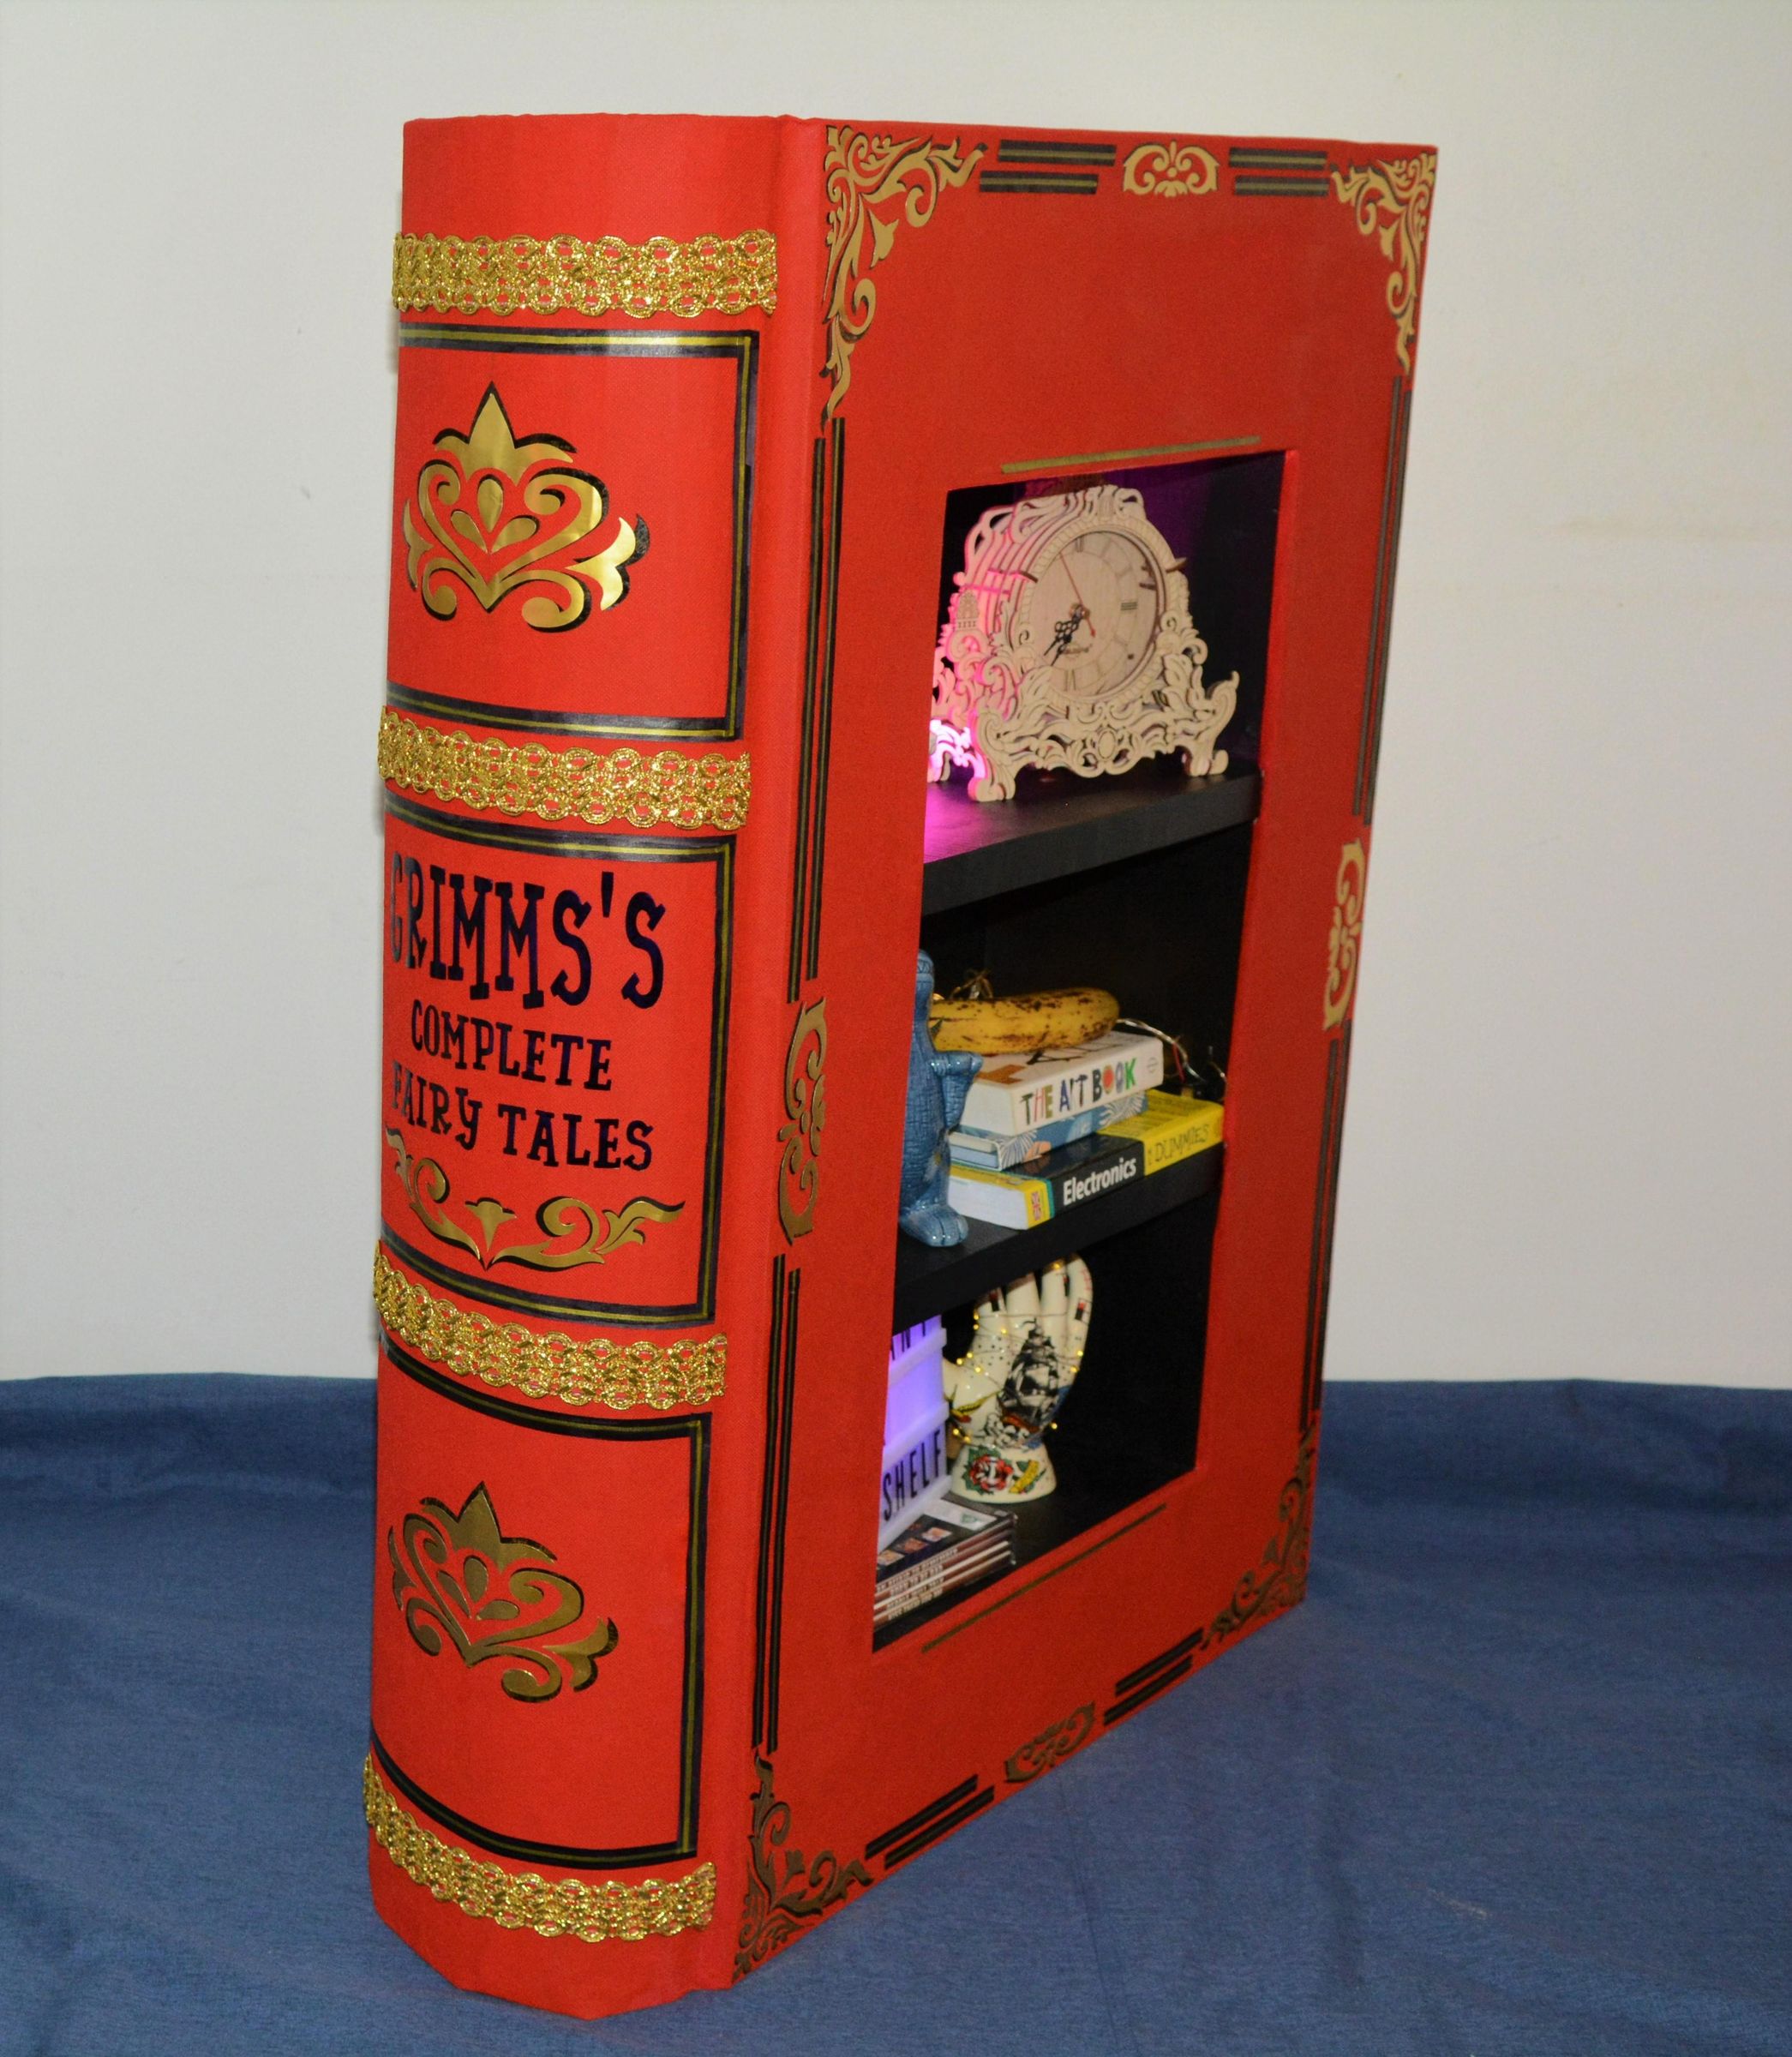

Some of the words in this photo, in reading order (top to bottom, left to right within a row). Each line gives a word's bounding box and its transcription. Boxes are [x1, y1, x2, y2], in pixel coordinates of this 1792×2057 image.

[391, 851, 666, 1009] GRIMMS'S
[411, 999, 612, 1091] COMPLETE
[391, 1060, 482, 1149] FAIRY
[498, 1104, 654, 1171] TALES
[1020, 1085, 1053, 1125] THE
[1092, 1058, 1138, 1102] BOOK
[1064, 1157, 1137, 1206] Electronics
[1154, 1124, 1209, 1162] DUMMIES
[883, 1429, 941, 1521] SHELF
